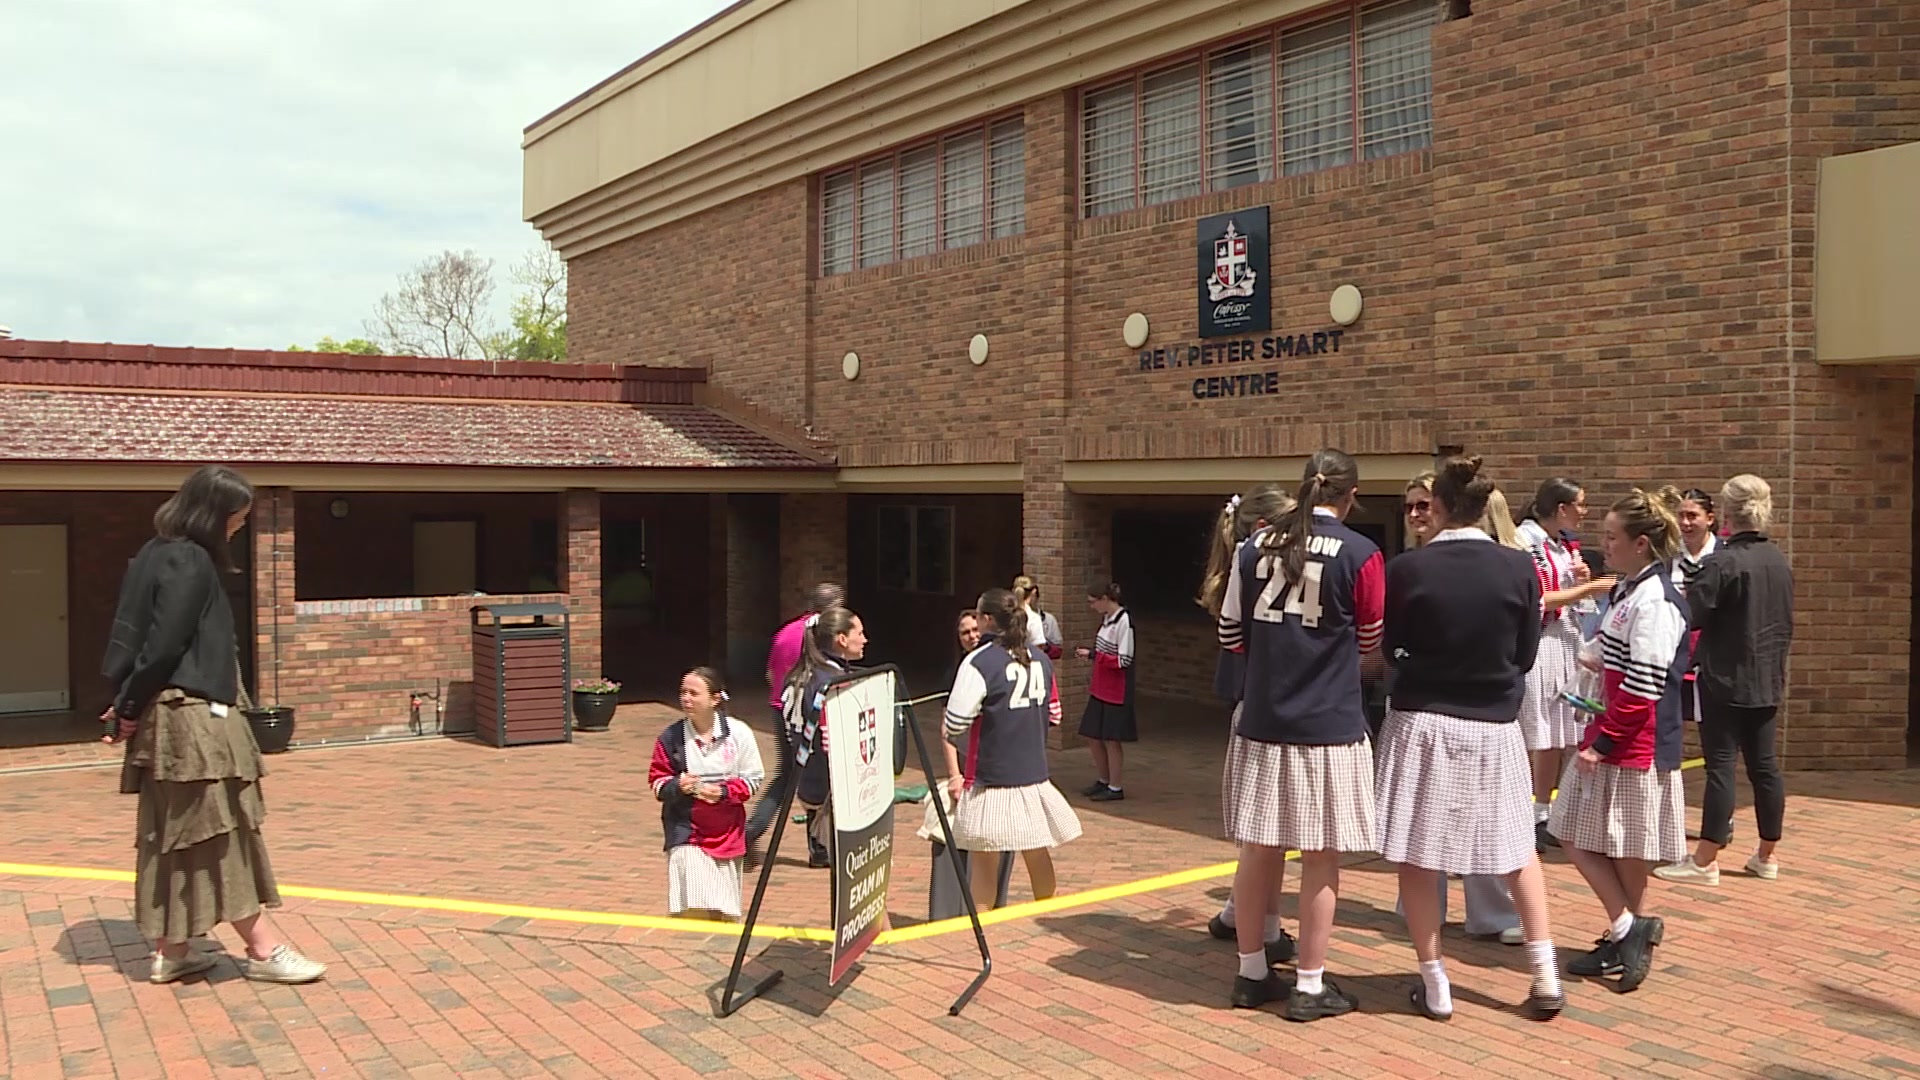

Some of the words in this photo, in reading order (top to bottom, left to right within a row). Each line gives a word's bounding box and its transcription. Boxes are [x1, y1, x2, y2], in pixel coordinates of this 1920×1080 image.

[1140, 349, 1182, 370] REV.
[1188, 340, 1255, 366] PETER
[1261, 330, 1344, 359] SMART
[1192, 372, 1279, 399] CENTRE
[1253, 556, 1325, 629] 24
[1005, 660, 1046, 710] 24
[846, 846, 869, 879] Quiet
[869, 833, 891, 860] Please
[849, 872, 876, 910] EXAM
[875, 863, 886, 889] IN
[841, 891, 886, 948] PROGRESS
